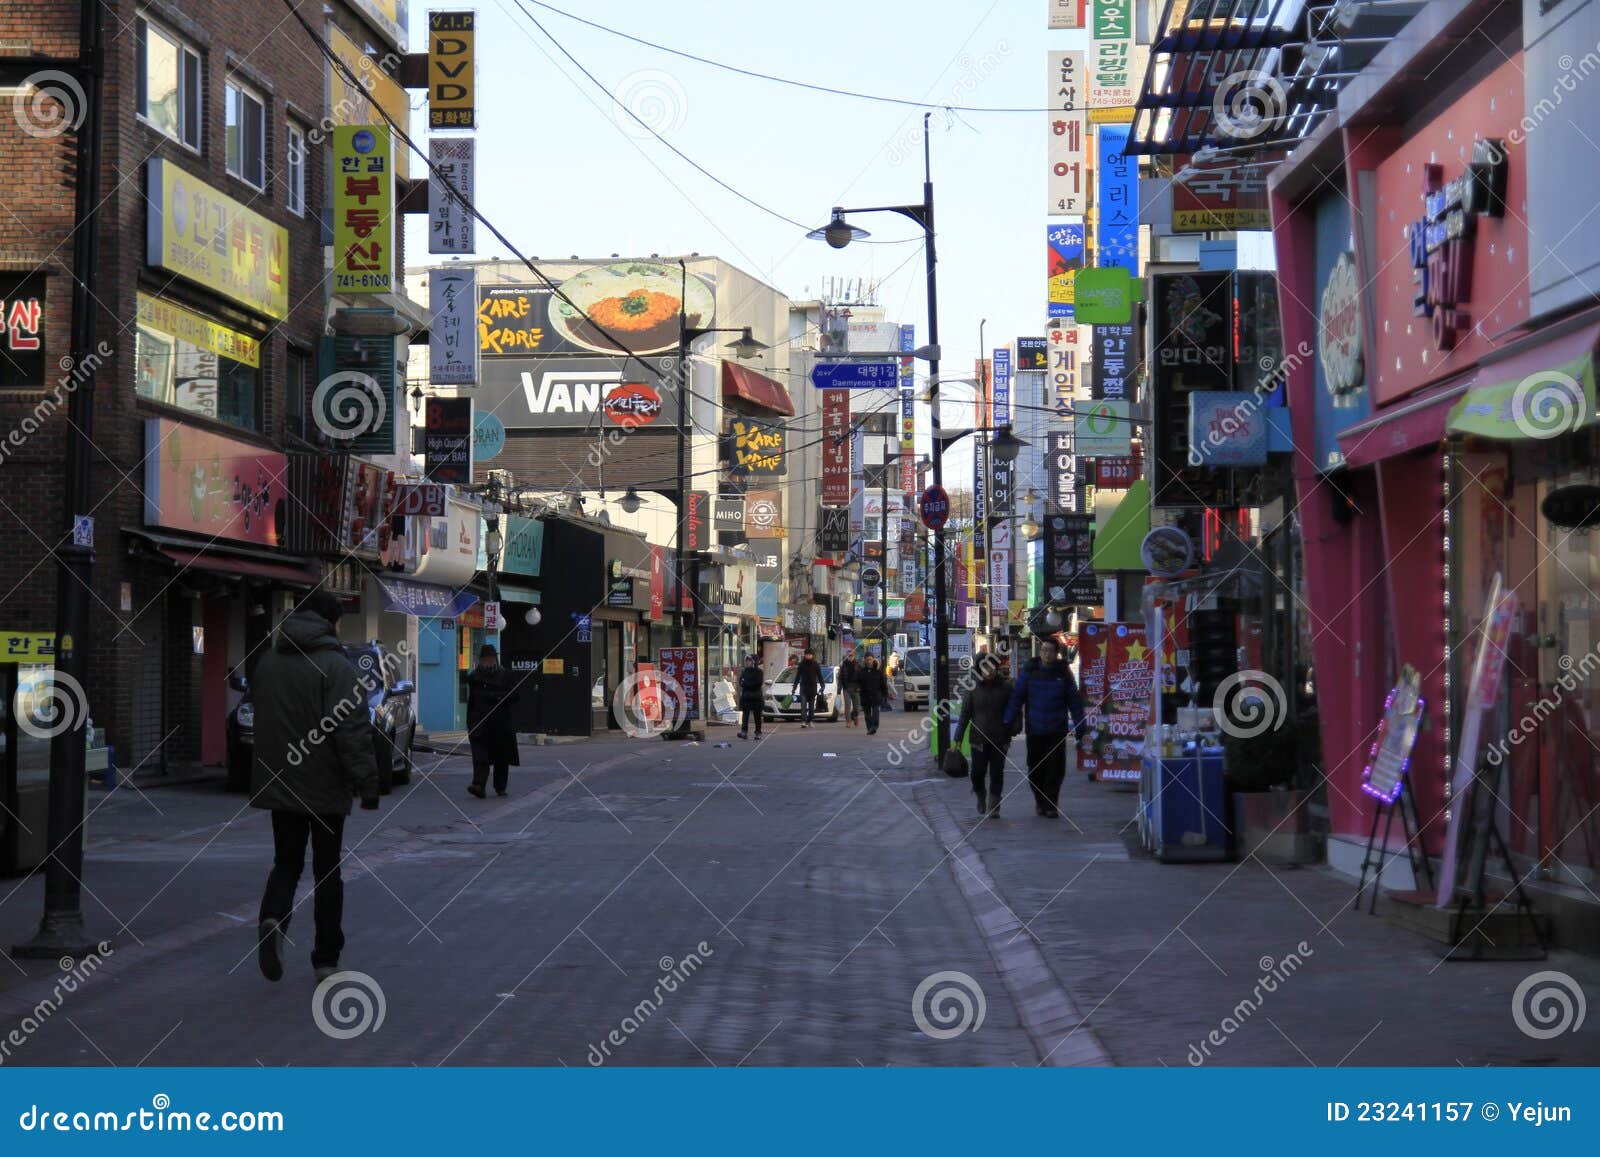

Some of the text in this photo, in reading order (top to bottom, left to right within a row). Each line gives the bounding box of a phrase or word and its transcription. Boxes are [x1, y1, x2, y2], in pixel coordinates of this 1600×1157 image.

[432, 15, 472, 28] V.I.P
[435, 38, 468, 101] DVD
[431, 111, 472, 125] 영화방
[340, 156, 385, 173] 한길
[1051, 119, 1080, 194] 헤어
[1058, 199, 1077, 210] 4F
[344, 176, 382, 271] 부동산
[336, 273, 390, 288] 741-6100
[478, 296, 531, 325] KARE
[0, 297, 41, 349] 산
[479, 322, 544, 354] KARE
[716, 511, 742, 520] MIHO
[512, 660, 538, 669] LUSH
[1108, 670, 1154, 682] CHRISTMA
